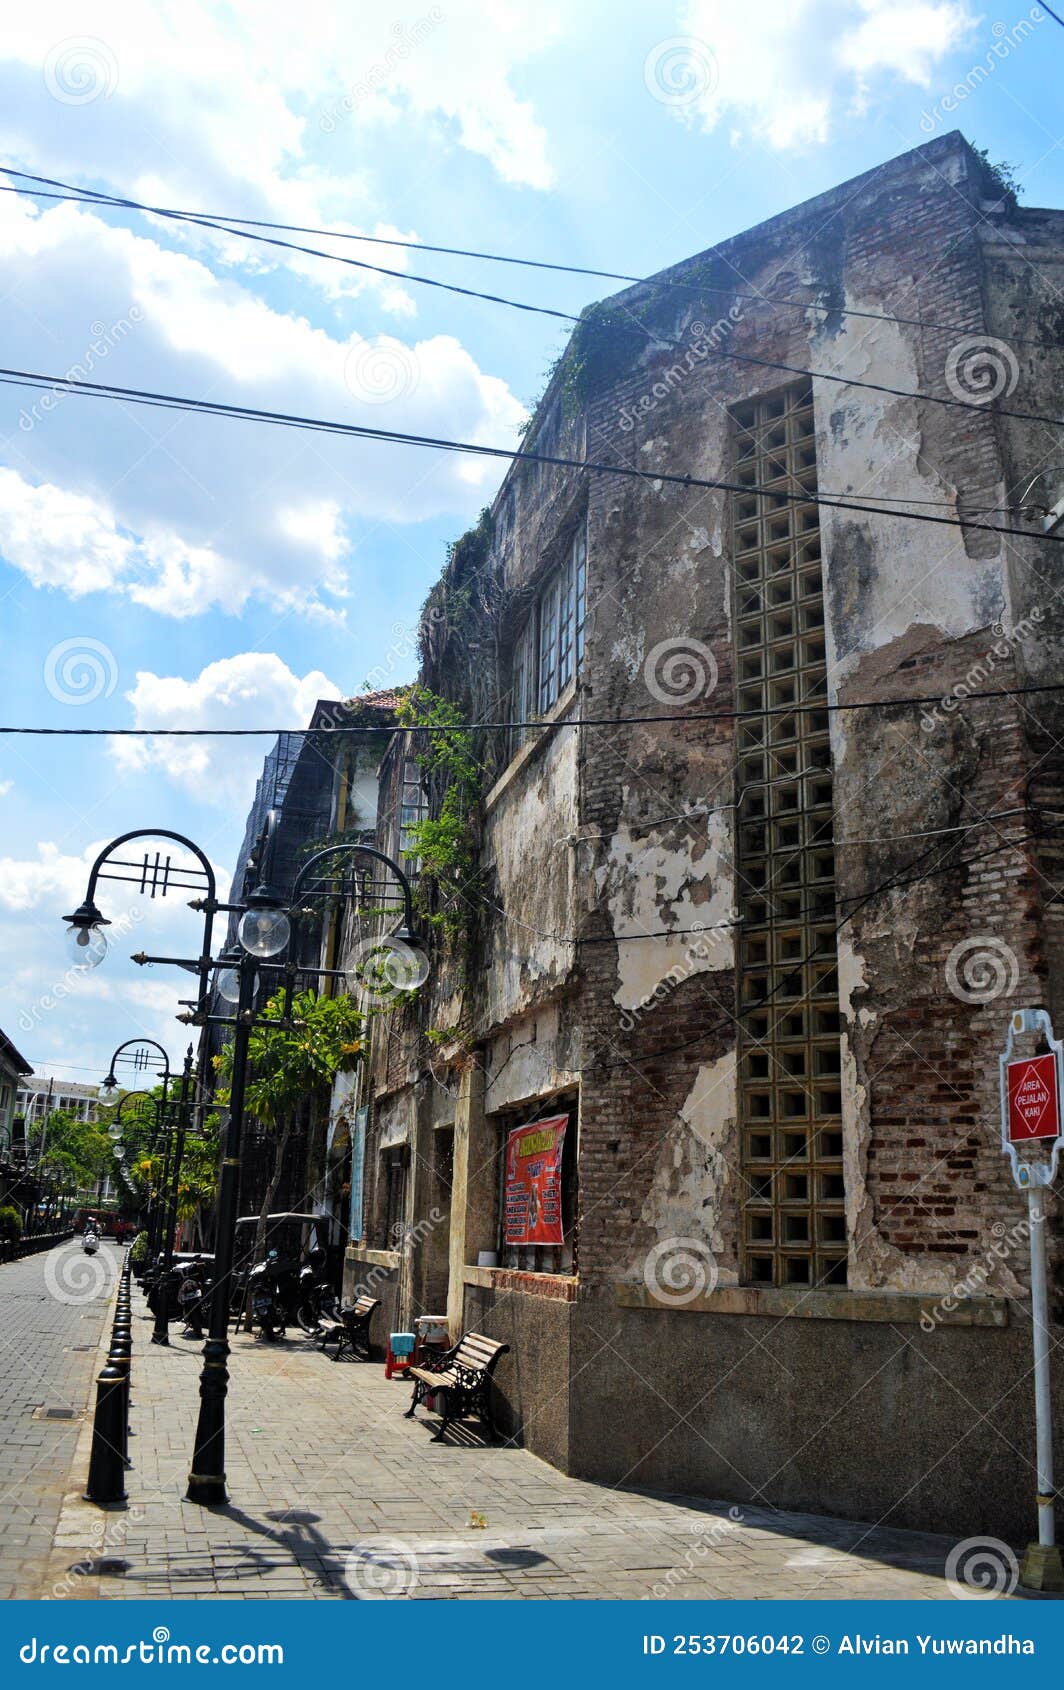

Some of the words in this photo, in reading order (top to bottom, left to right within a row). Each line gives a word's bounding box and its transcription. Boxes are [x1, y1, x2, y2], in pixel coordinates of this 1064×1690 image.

[1023, 1080, 1040, 1091] AREA
[1018, 1092, 1046, 1105] PEJALAN
[1024, 1107, 1040, 1117] KAKI
